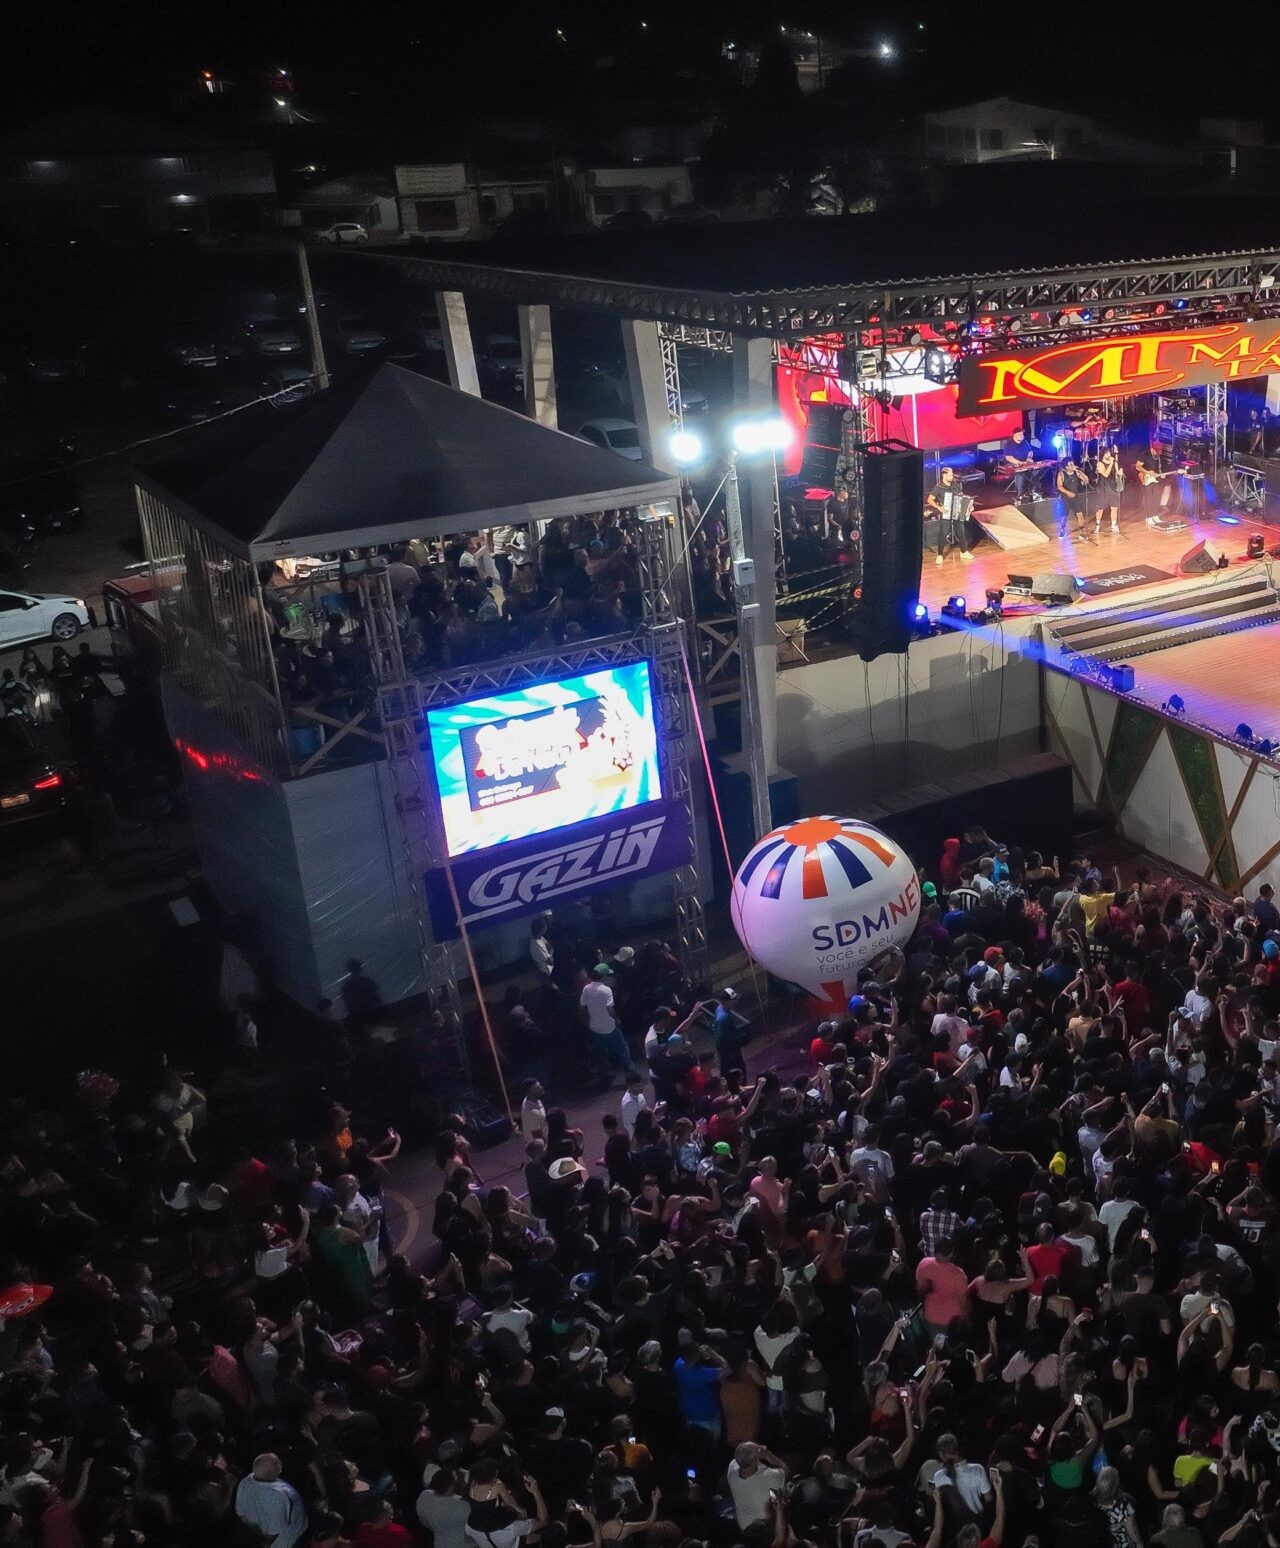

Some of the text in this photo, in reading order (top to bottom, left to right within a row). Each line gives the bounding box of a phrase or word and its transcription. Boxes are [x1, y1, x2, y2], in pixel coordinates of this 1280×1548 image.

[467, 816, 667, 907] GAZIN
[816, 947, 854, 964] você
[858, 945, 868, 955] e
[871, 933, 894, 951] seu
